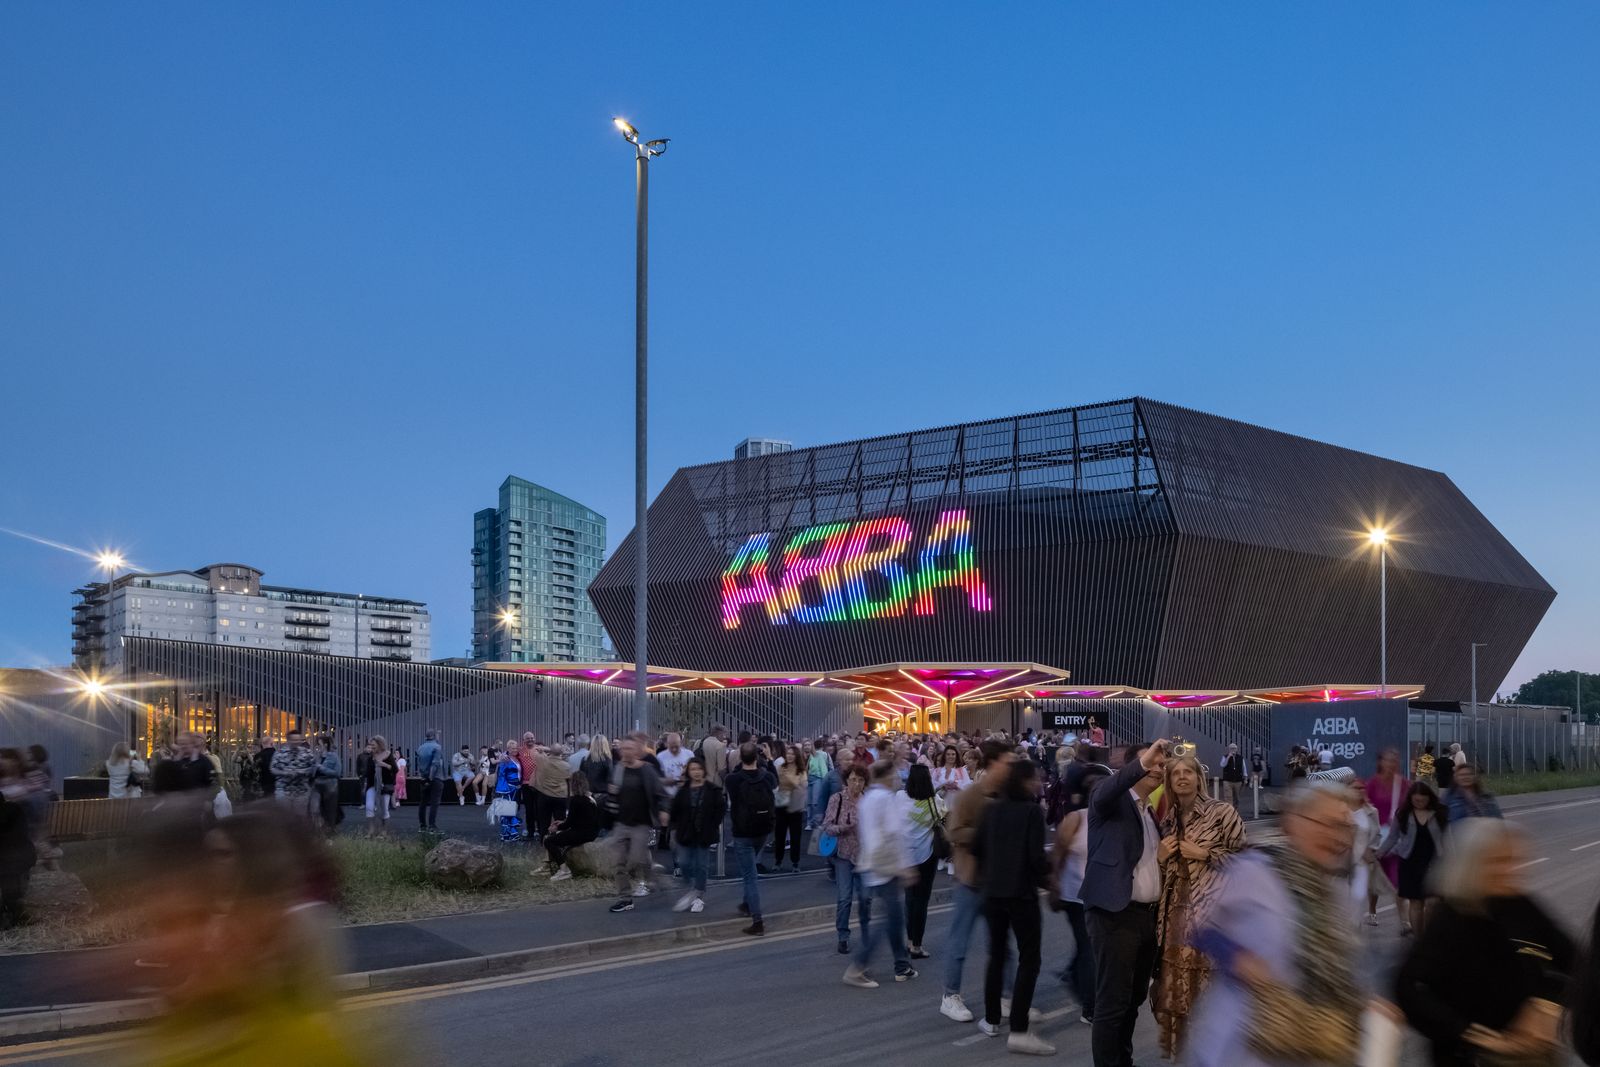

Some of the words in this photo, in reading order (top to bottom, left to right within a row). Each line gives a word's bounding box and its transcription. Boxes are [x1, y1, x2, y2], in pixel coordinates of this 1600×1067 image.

[722, 510, 992, 630] ABBA
[1054, 715, 1087, 725] ENTRY
[1312, 717, 1360, 735] ABBA
